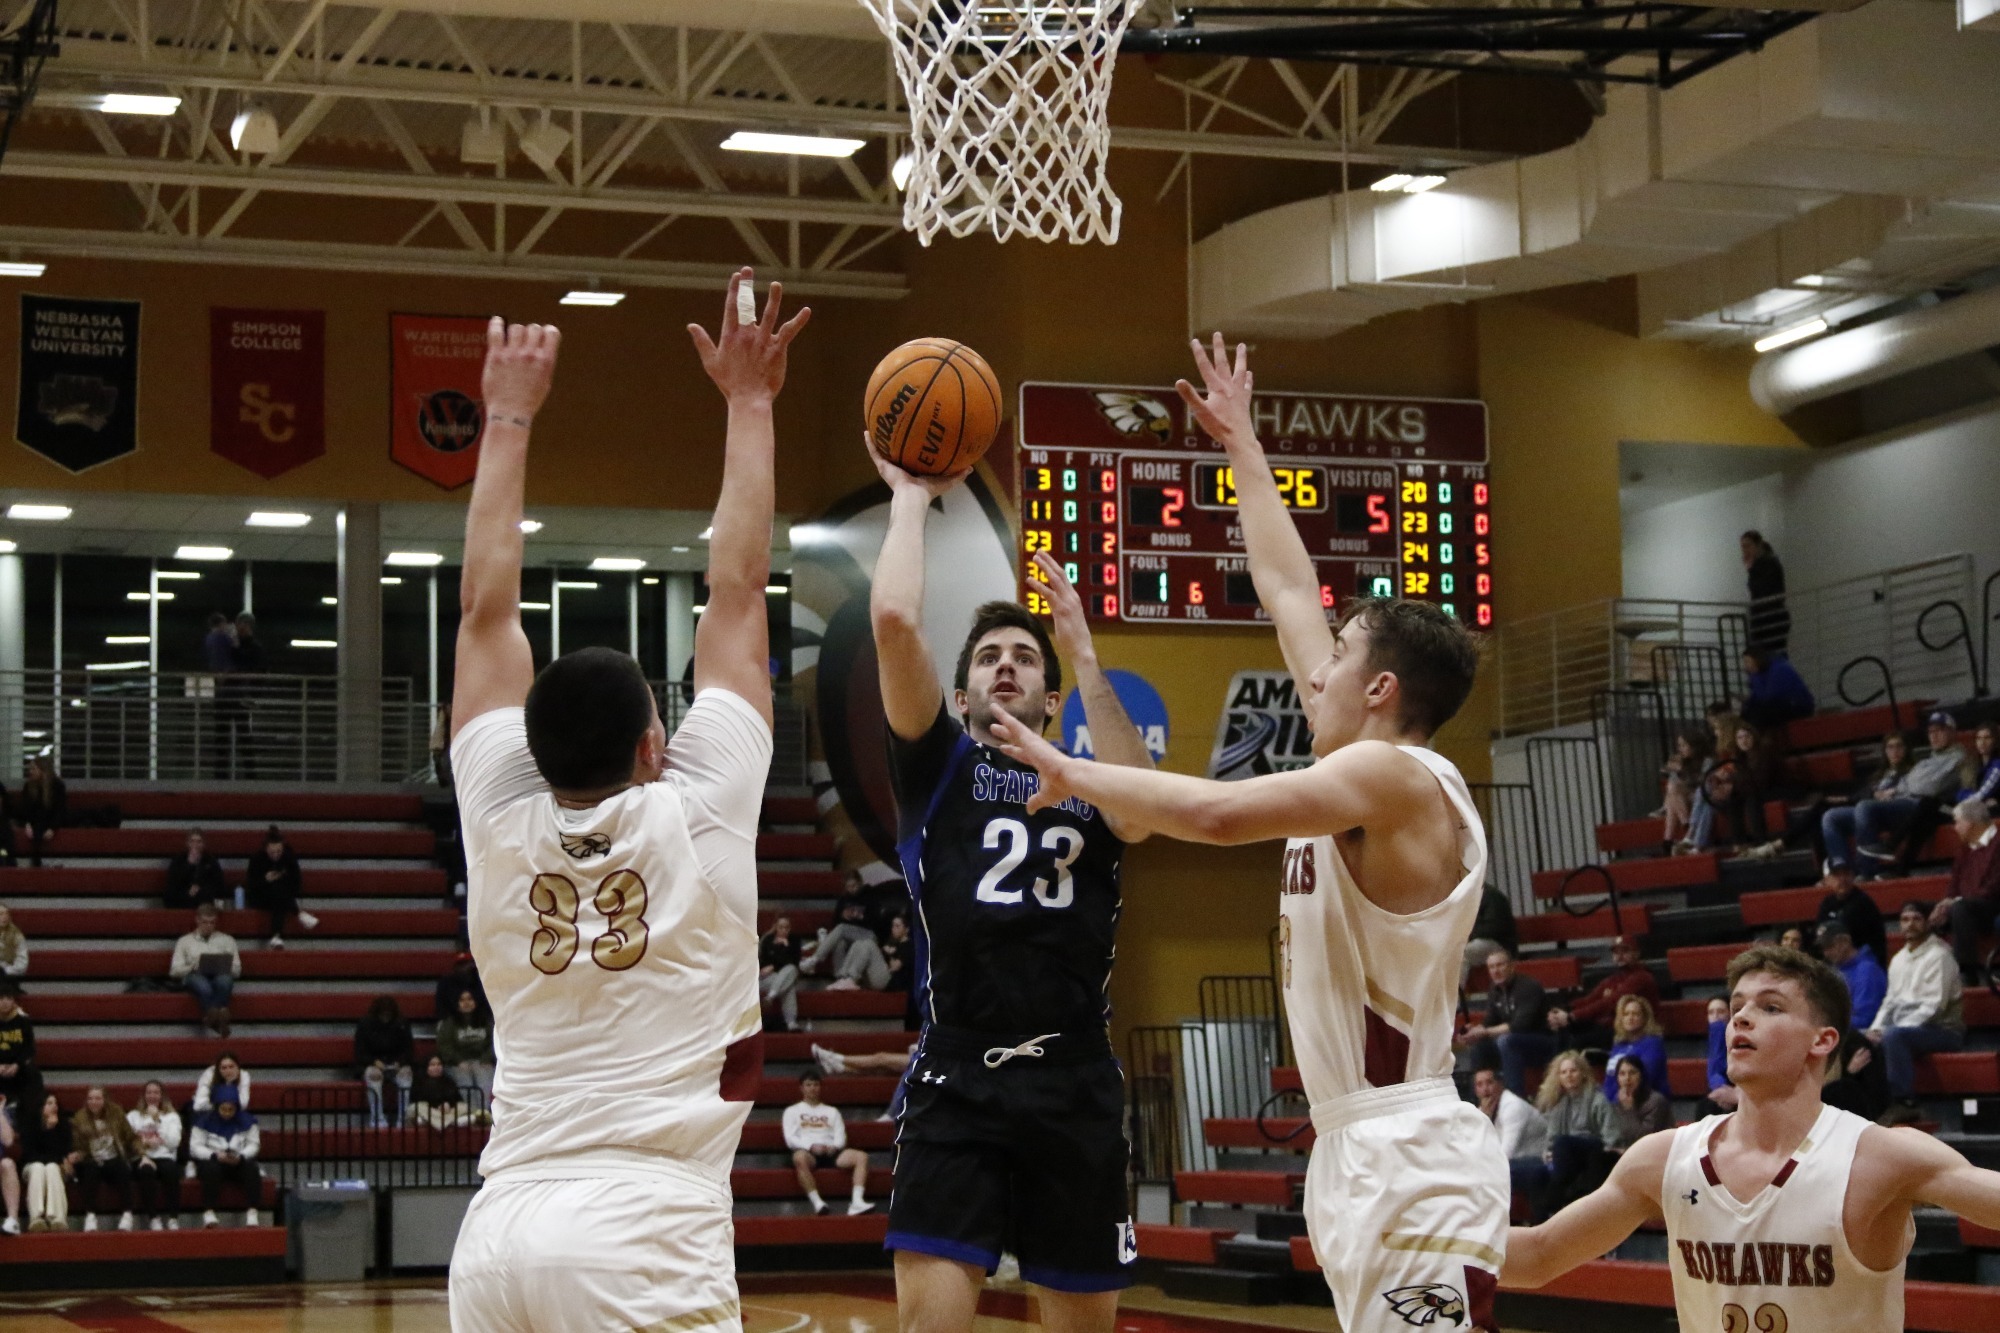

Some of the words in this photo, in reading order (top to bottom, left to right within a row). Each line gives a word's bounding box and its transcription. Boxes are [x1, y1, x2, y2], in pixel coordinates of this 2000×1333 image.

[36, 311, 122, 327] NEBRASKA
[231, 321, 301, 336] SIMPSON
[35, 325, 123, 342] WESLEYAN
[231, 336, 302, 350] COLLEGE
[31, 339, 125, 357] UNIVERSITY
[412, 346, 482, 358] COLLEGE
[1185, 400, 1426, 443] HAWKS
[1031, 450, 1048, 465] NO
[1065, 452, 1073, 465] F
[1090, 452, 1114, 467] PTS
[1038, 469, 1051, 491] 3
[1063, 469, 1077, 492] 0
[1101, 470, 1115, 493] 0
[1132, 463, 1181, 481] HOME
[1330, 469, 1393, 488] VISITOR
[1406, 465, 1424, 477] NO
[1440, 466, 1447, 478] F
[1463, 466, 1486, 479] PTS
[1402, 481, 1428, 503] 20
[1438, 482, 1452, 504] 0
[1474, 483, 1488, 505] 0
[1032, 500, 1051, 521] 11
[1063, 500, 1077, 522] 0
[1102, 501, 1116, 524] 0
[1162, 488, 1184, 527] 2
[1367, 495, 1390, 534] 5
[1402, 511, 1428, 533] 23
[1439, 512, 1452, 534] 0
[1475, 513, 1489, 535] 0
[1025, 530, 1052, 552] 23
[1071, 532, 1078, 552] 1
[1103, 532, 1116, 555] 2
[1151, 533, 1191, 547] BONUS
[1330, 538, 1369, 553] BONUS
[1130, 556, 1168, 570] FOULS
[1403, 541, 1429, 563] 24
[1440, 543, 1453, 564] 0
[1475, 543, 1489, 565] 5
[1064, 562, 1078, 584] 0
[1103, 563, 1117, 586] 0
[1216, 558, 1250, 571] PLAY
[1355, 563, 1392, 576] FOULS
[1159, 572, 1168, 602] 1
[1189, 582, 1203, 604] 6
[1404, 572, 1430, 594] 32
[1440, 573, 1454, 594] 0
[1476, 573, 1490, 595] 0
[1103, 594, 1117, 617] 0
[1320, 585, 1334, 607] 6
[1130, 605, 1170, 618] POINTS
[1185, 606, 1208, 619] TOL
[1477, 604, 1491, 626] 0
[973, 763, 1094, 821] SPAR
[976, 818, 1085, 908] 23
[529, 868, 650, 976] 33
[1676, 1239, 1836, 1288] KOHAWKS
